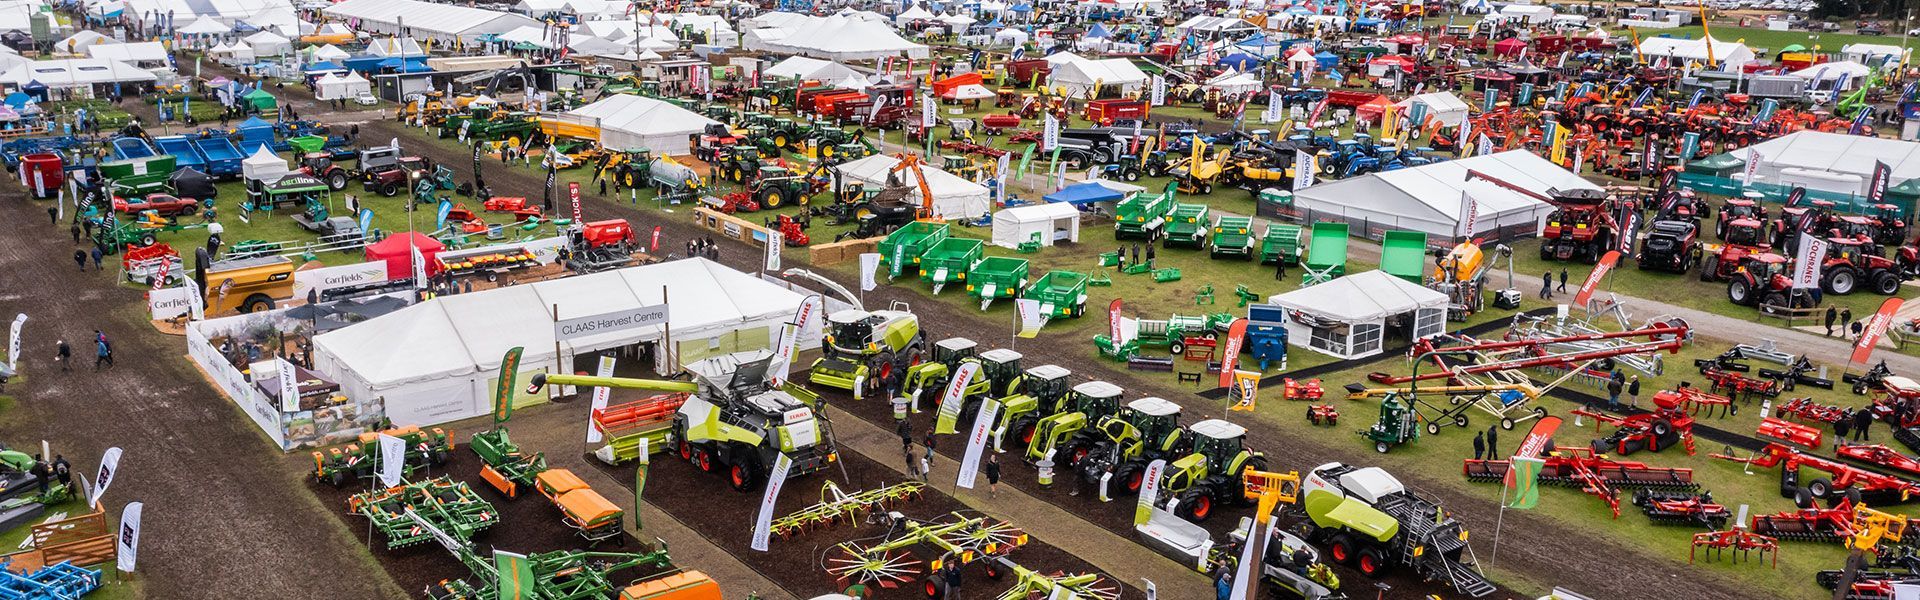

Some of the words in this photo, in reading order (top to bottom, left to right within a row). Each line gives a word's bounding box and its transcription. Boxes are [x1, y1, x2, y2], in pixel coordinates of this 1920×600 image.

[281, 176, 314, 186] agriline
[1624, 214, 1636, 243] CASE
[1804, 240, 1820, 284] COCHRANES
[324, 273, 363, 285] Carrfields
[562, 321, 595, 336] CLAAS
[597, 316, 631, 330] Harvest
[633, 311, 663, 323] Centre
[798, 302, 811, 328] CLAAS
[500, 351, 515, 419] AMAZONE
[952, 368, 968, 398] CLAAS
[789, 411, 808, 420] CLAAS
[975, 424, 985, 445] CLAAS
[1147, 466, 1157, 490] CLAAS
[1311, 477, 1325, 488] CLAAS
[767, 481, 777, 504] CLAAS
